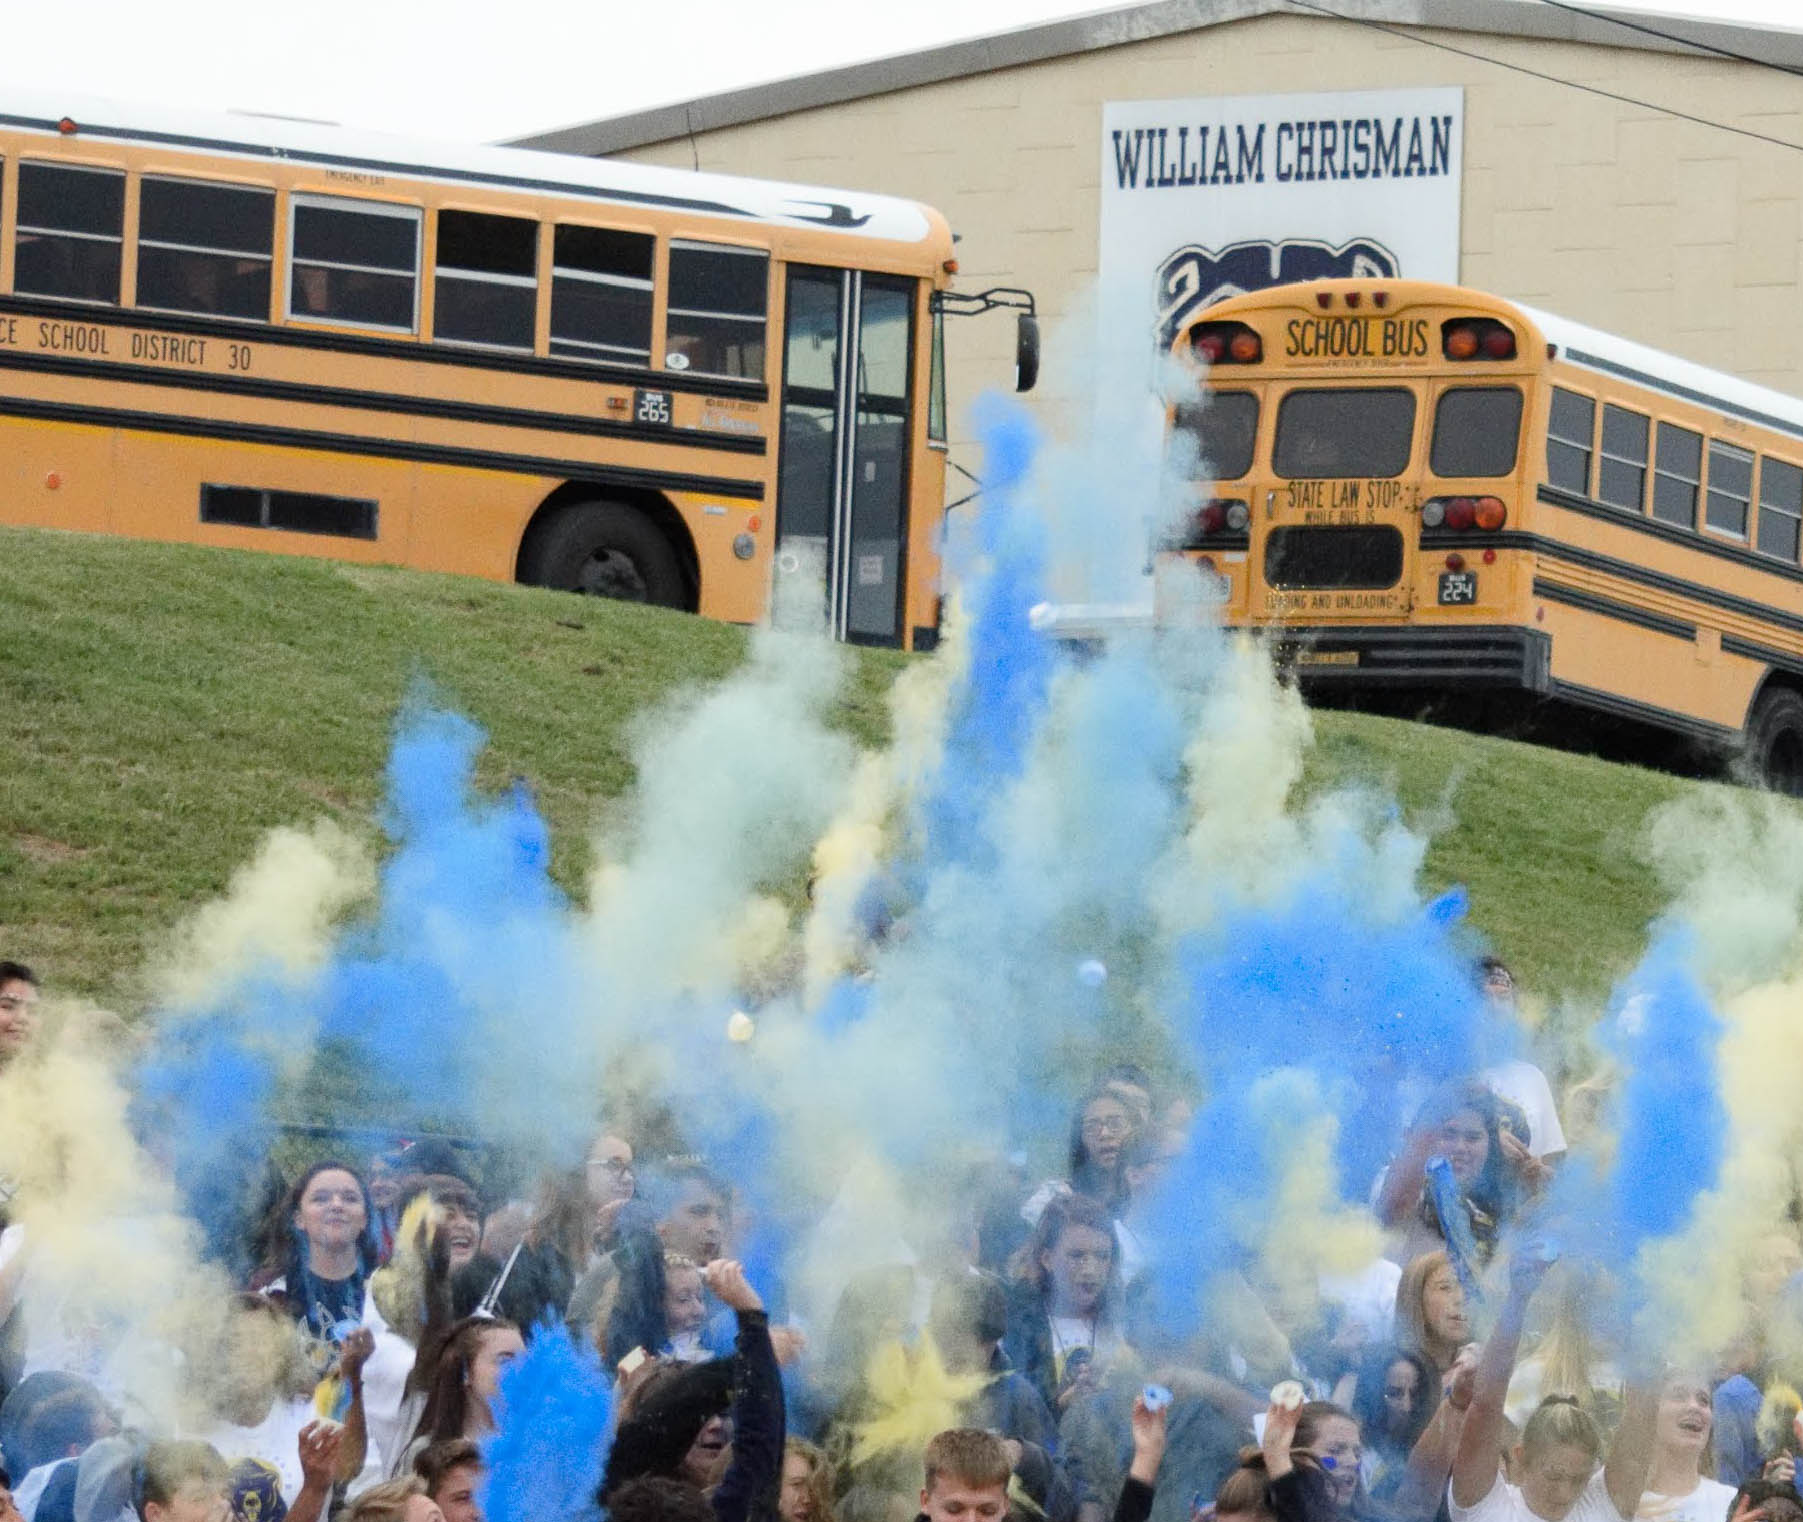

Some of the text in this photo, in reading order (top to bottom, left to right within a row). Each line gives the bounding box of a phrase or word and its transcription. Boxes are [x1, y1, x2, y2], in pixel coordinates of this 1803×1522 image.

[1112, 116, 1453, 189] WILLIAM CHRISMAN
[38, 322, 110, 355] SCHOOL
[131, 333, 207, 366] DISTRICT
[228, 344, 251, 371] 30
[1286, 317, 1429, 357] SCHOOL BUS
[638, 401, 669, 423] 265
[1288, 481, 1400, 508] STATE LAW STOP
[1312, 595, 1331, 608] AND
[1443, 582, 1472, 600] 224
